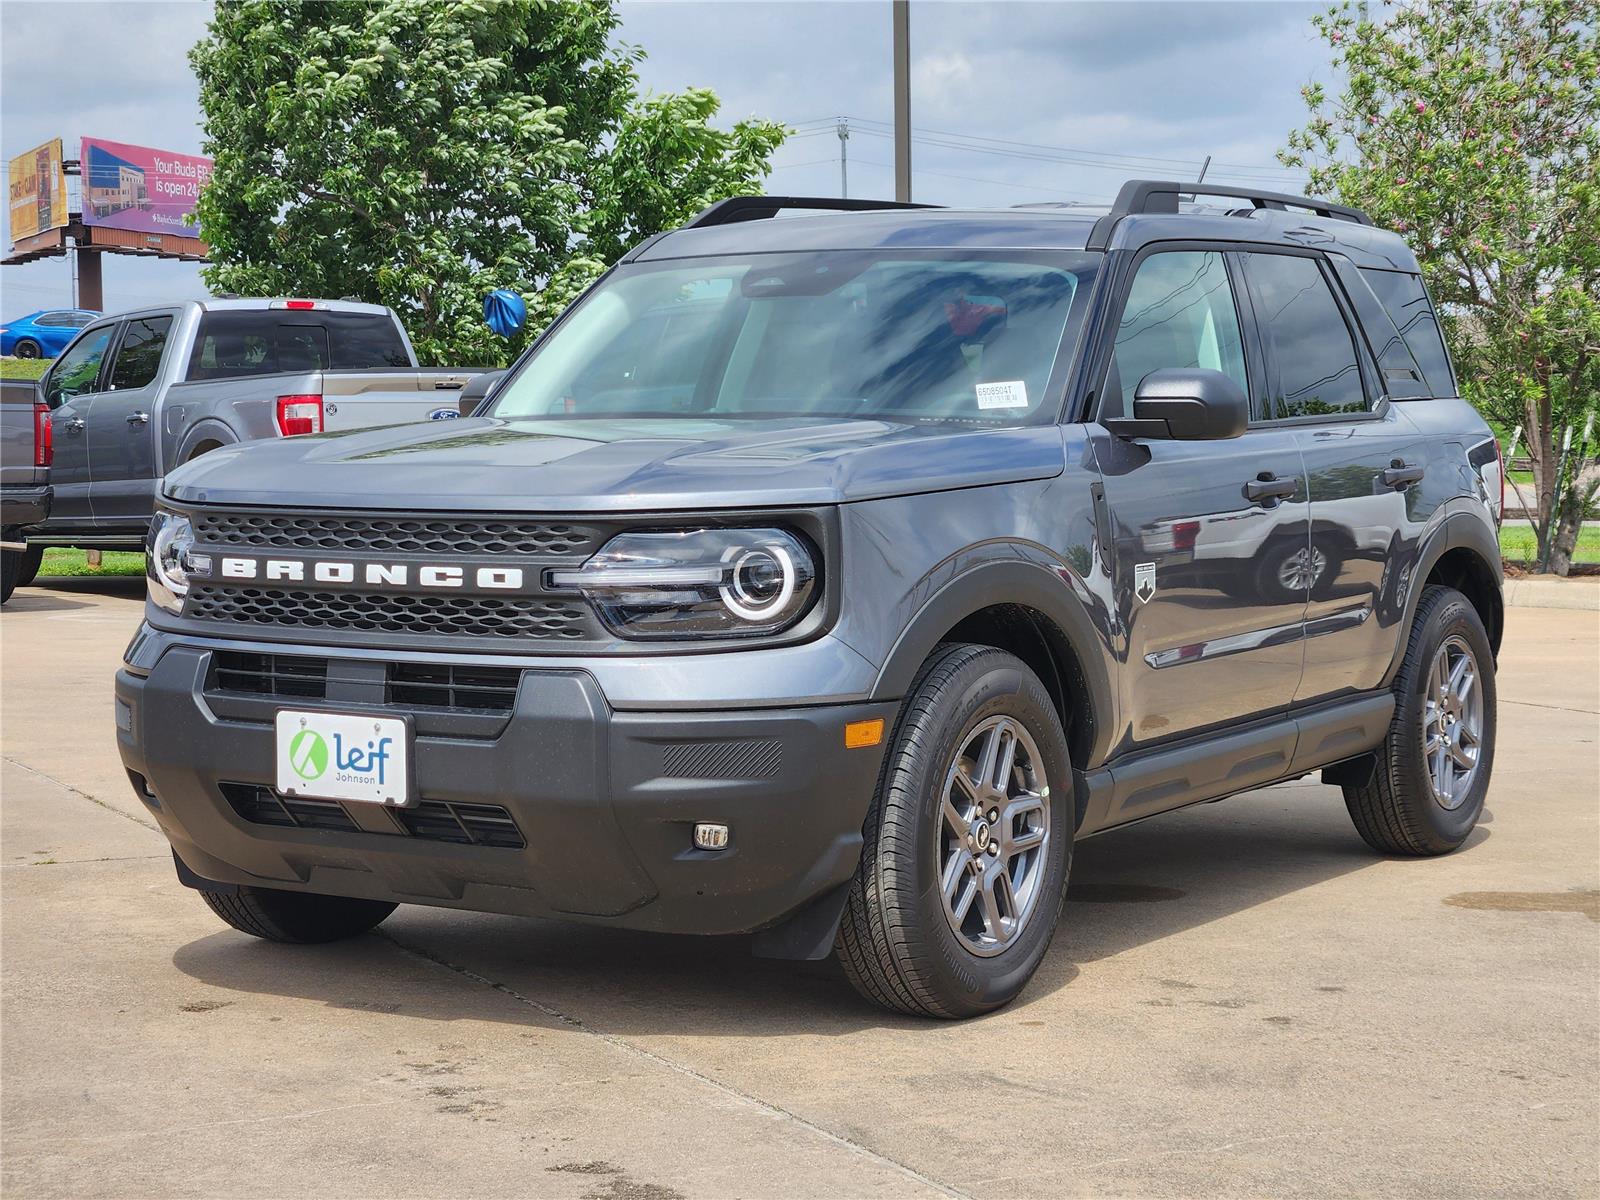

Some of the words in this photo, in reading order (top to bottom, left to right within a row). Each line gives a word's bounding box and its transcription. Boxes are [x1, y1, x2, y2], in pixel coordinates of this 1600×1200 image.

[153, 157, 173, 175] Your
[174, 160, 196, 178] Buda
[155, 176, 163, 192] is
[164, 181, 186, 198] open
[221, 557, 523, 589] BRONCO
[335, 772, 376, 785] Johnson
